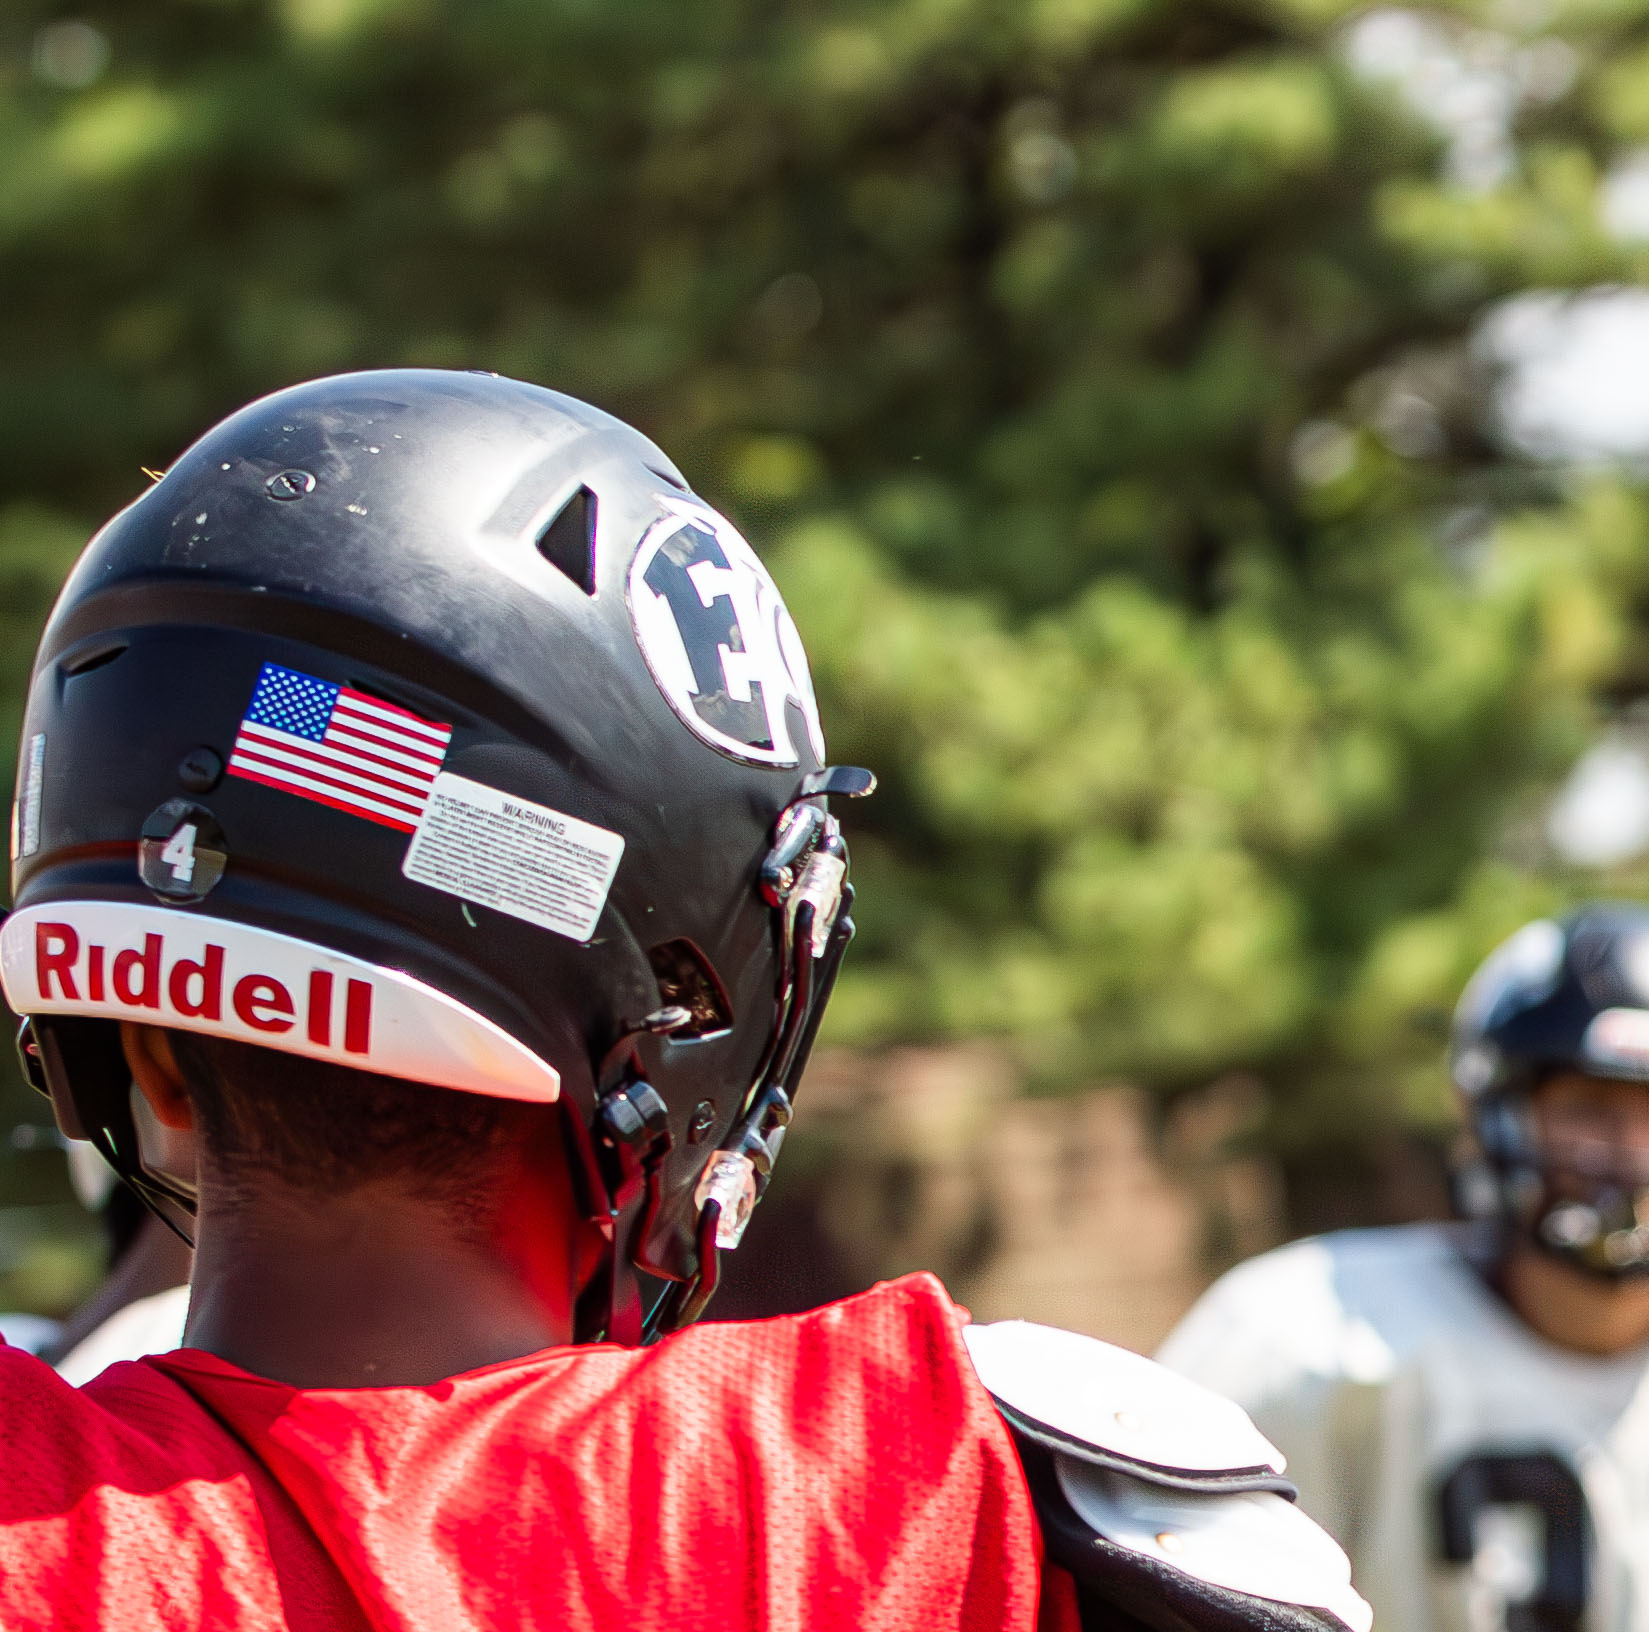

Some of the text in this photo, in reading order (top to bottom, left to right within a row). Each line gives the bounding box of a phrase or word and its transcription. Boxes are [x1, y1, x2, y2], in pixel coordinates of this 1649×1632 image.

[502, 801, 566, 836] WARNING
[161, 823, 198, 882] 4
[35, 922, 374, 1054] Riddell
